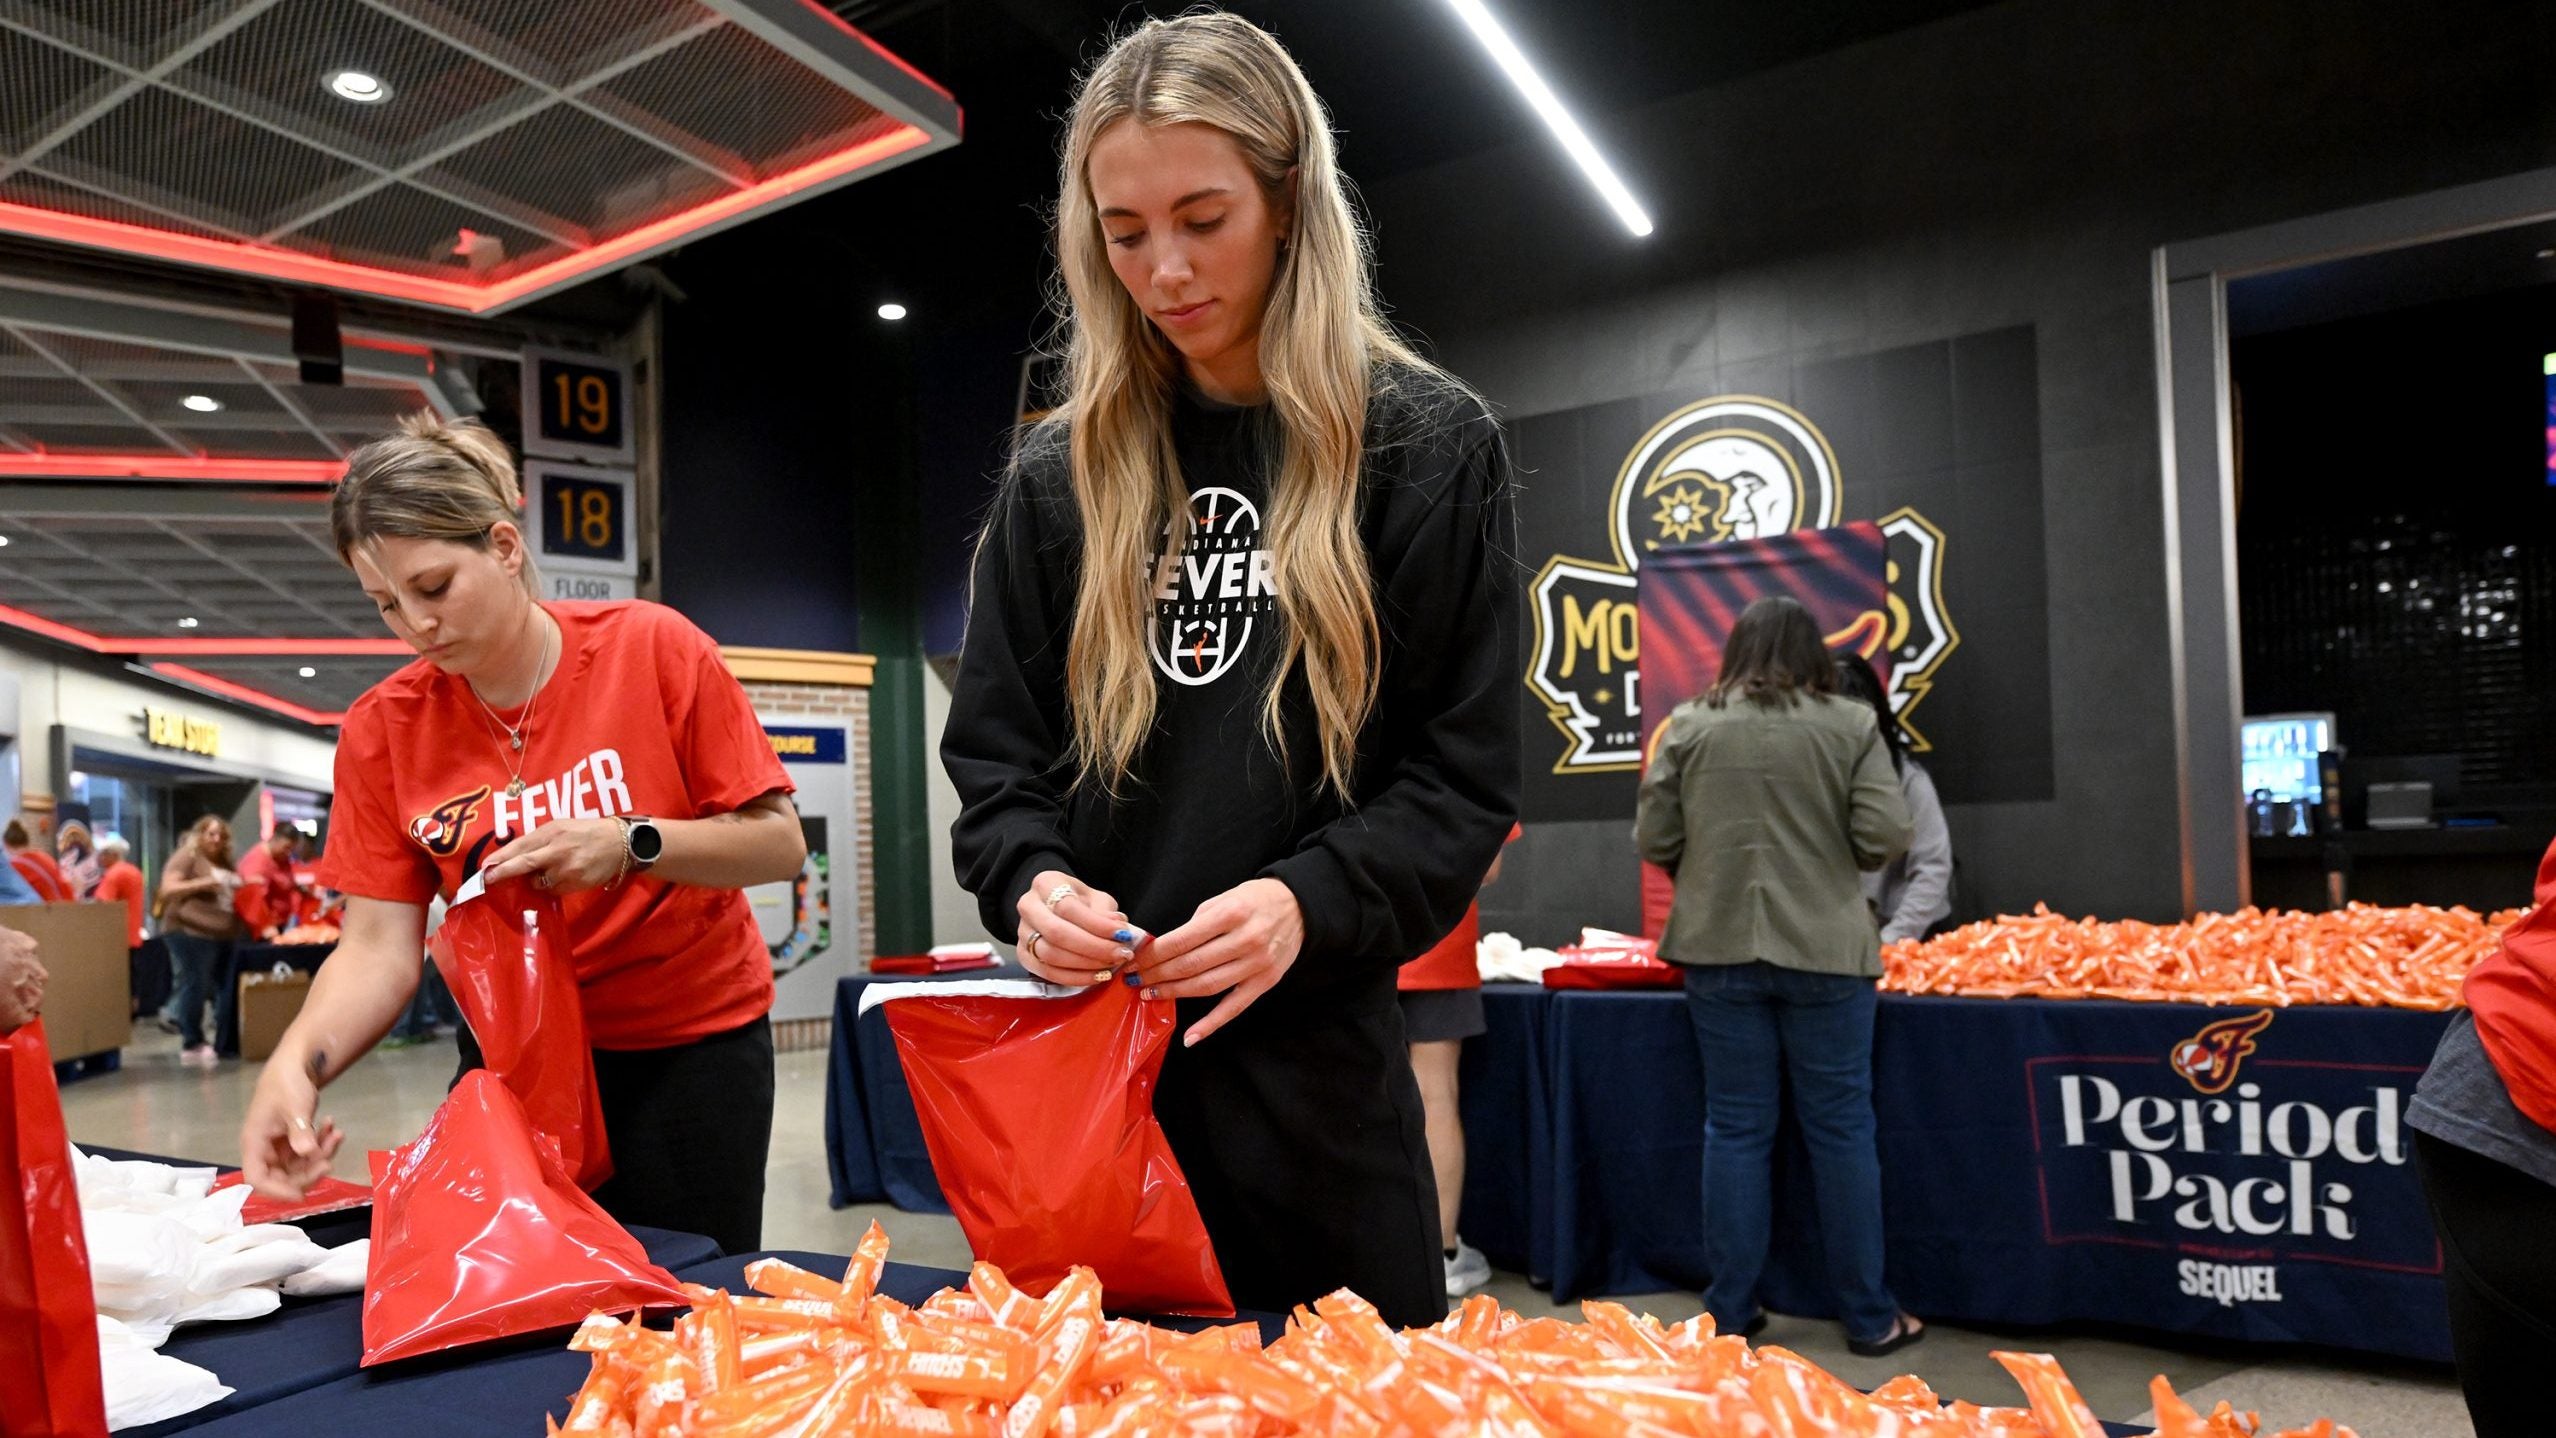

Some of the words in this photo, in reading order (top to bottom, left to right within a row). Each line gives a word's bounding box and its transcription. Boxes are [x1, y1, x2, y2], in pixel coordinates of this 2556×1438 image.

[554, 373, 610, 435] 19
[557, 488, 613, 549] 18
[555, 577, 611, 600] FLOOR
[2055, 1073, 2408, 1166] Period
[2100, 1149, 2358, 1241] Pack
[2177, 1258, 2283, 1307] SEQUEL
